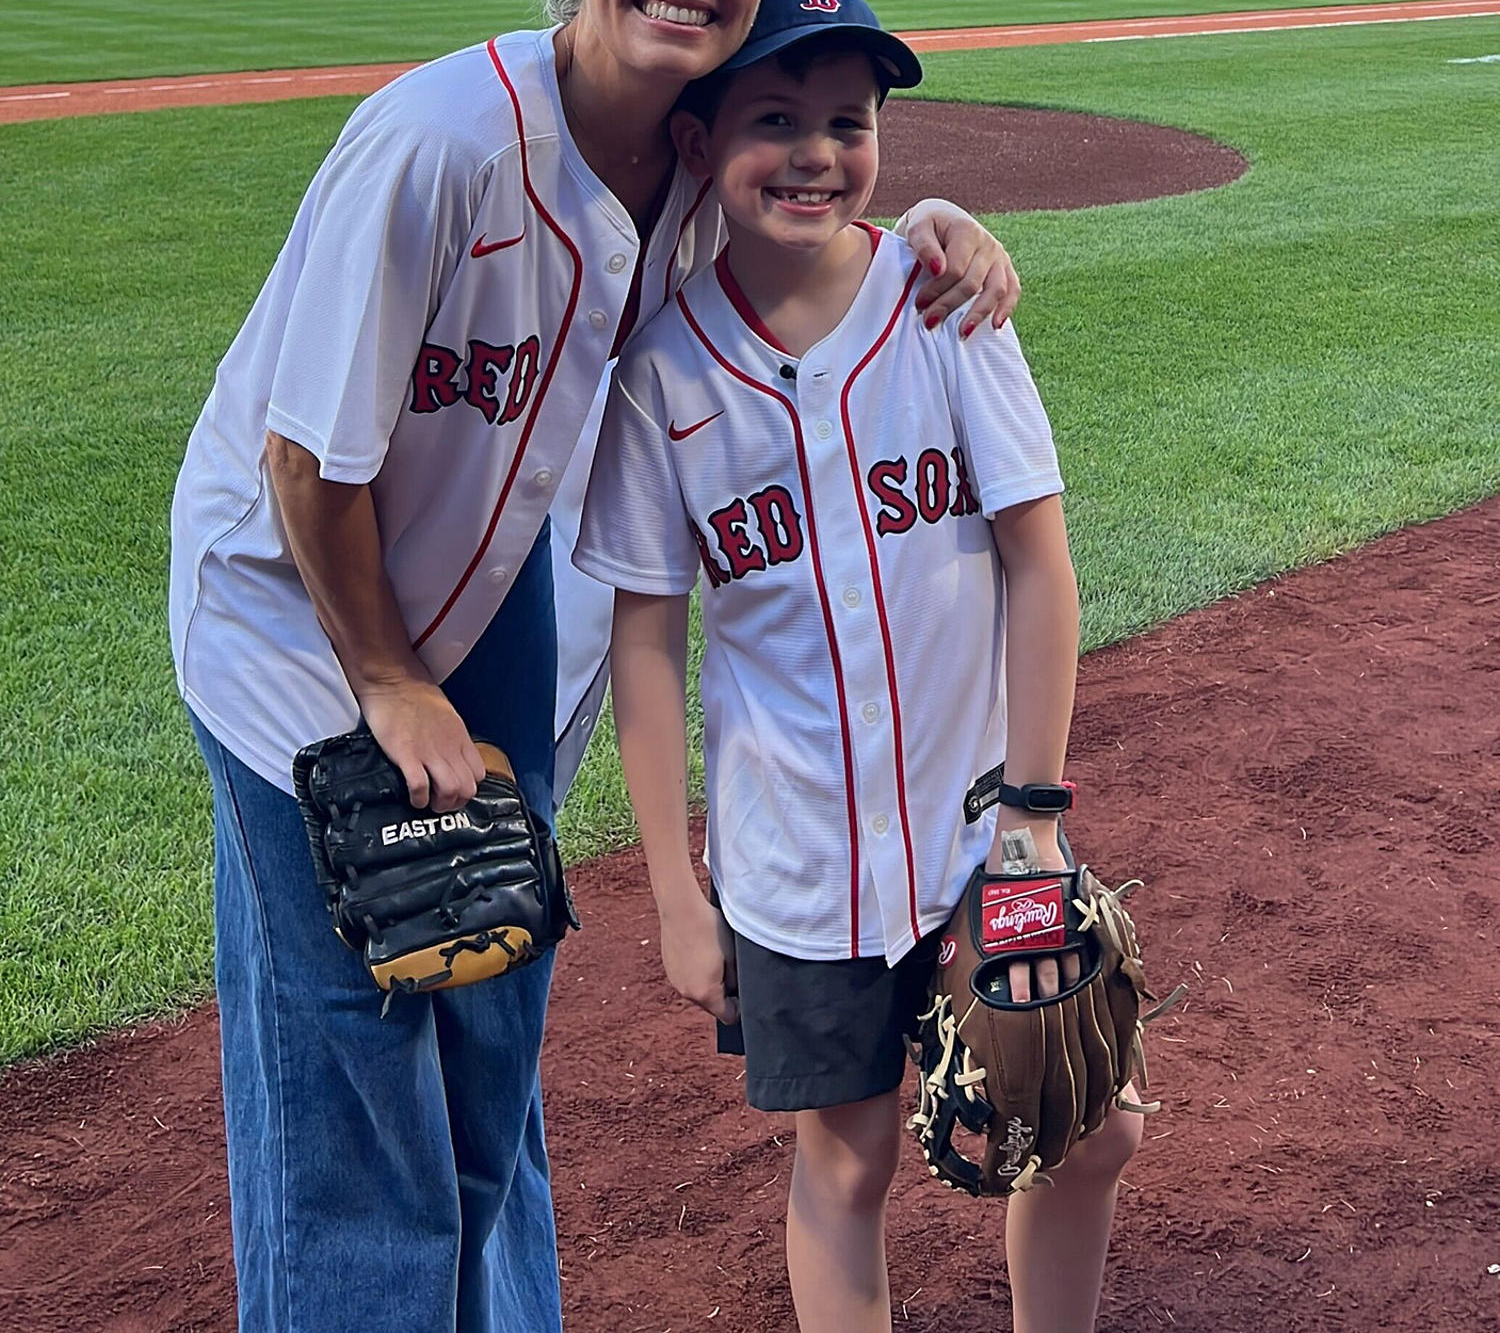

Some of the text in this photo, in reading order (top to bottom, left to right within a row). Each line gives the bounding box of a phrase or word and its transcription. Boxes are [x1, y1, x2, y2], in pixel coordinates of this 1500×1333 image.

[408, 334, 540, 426] RED
[382, 812, 472, 846] EASTON
[988, 901, 1058, 933] Rawlings
